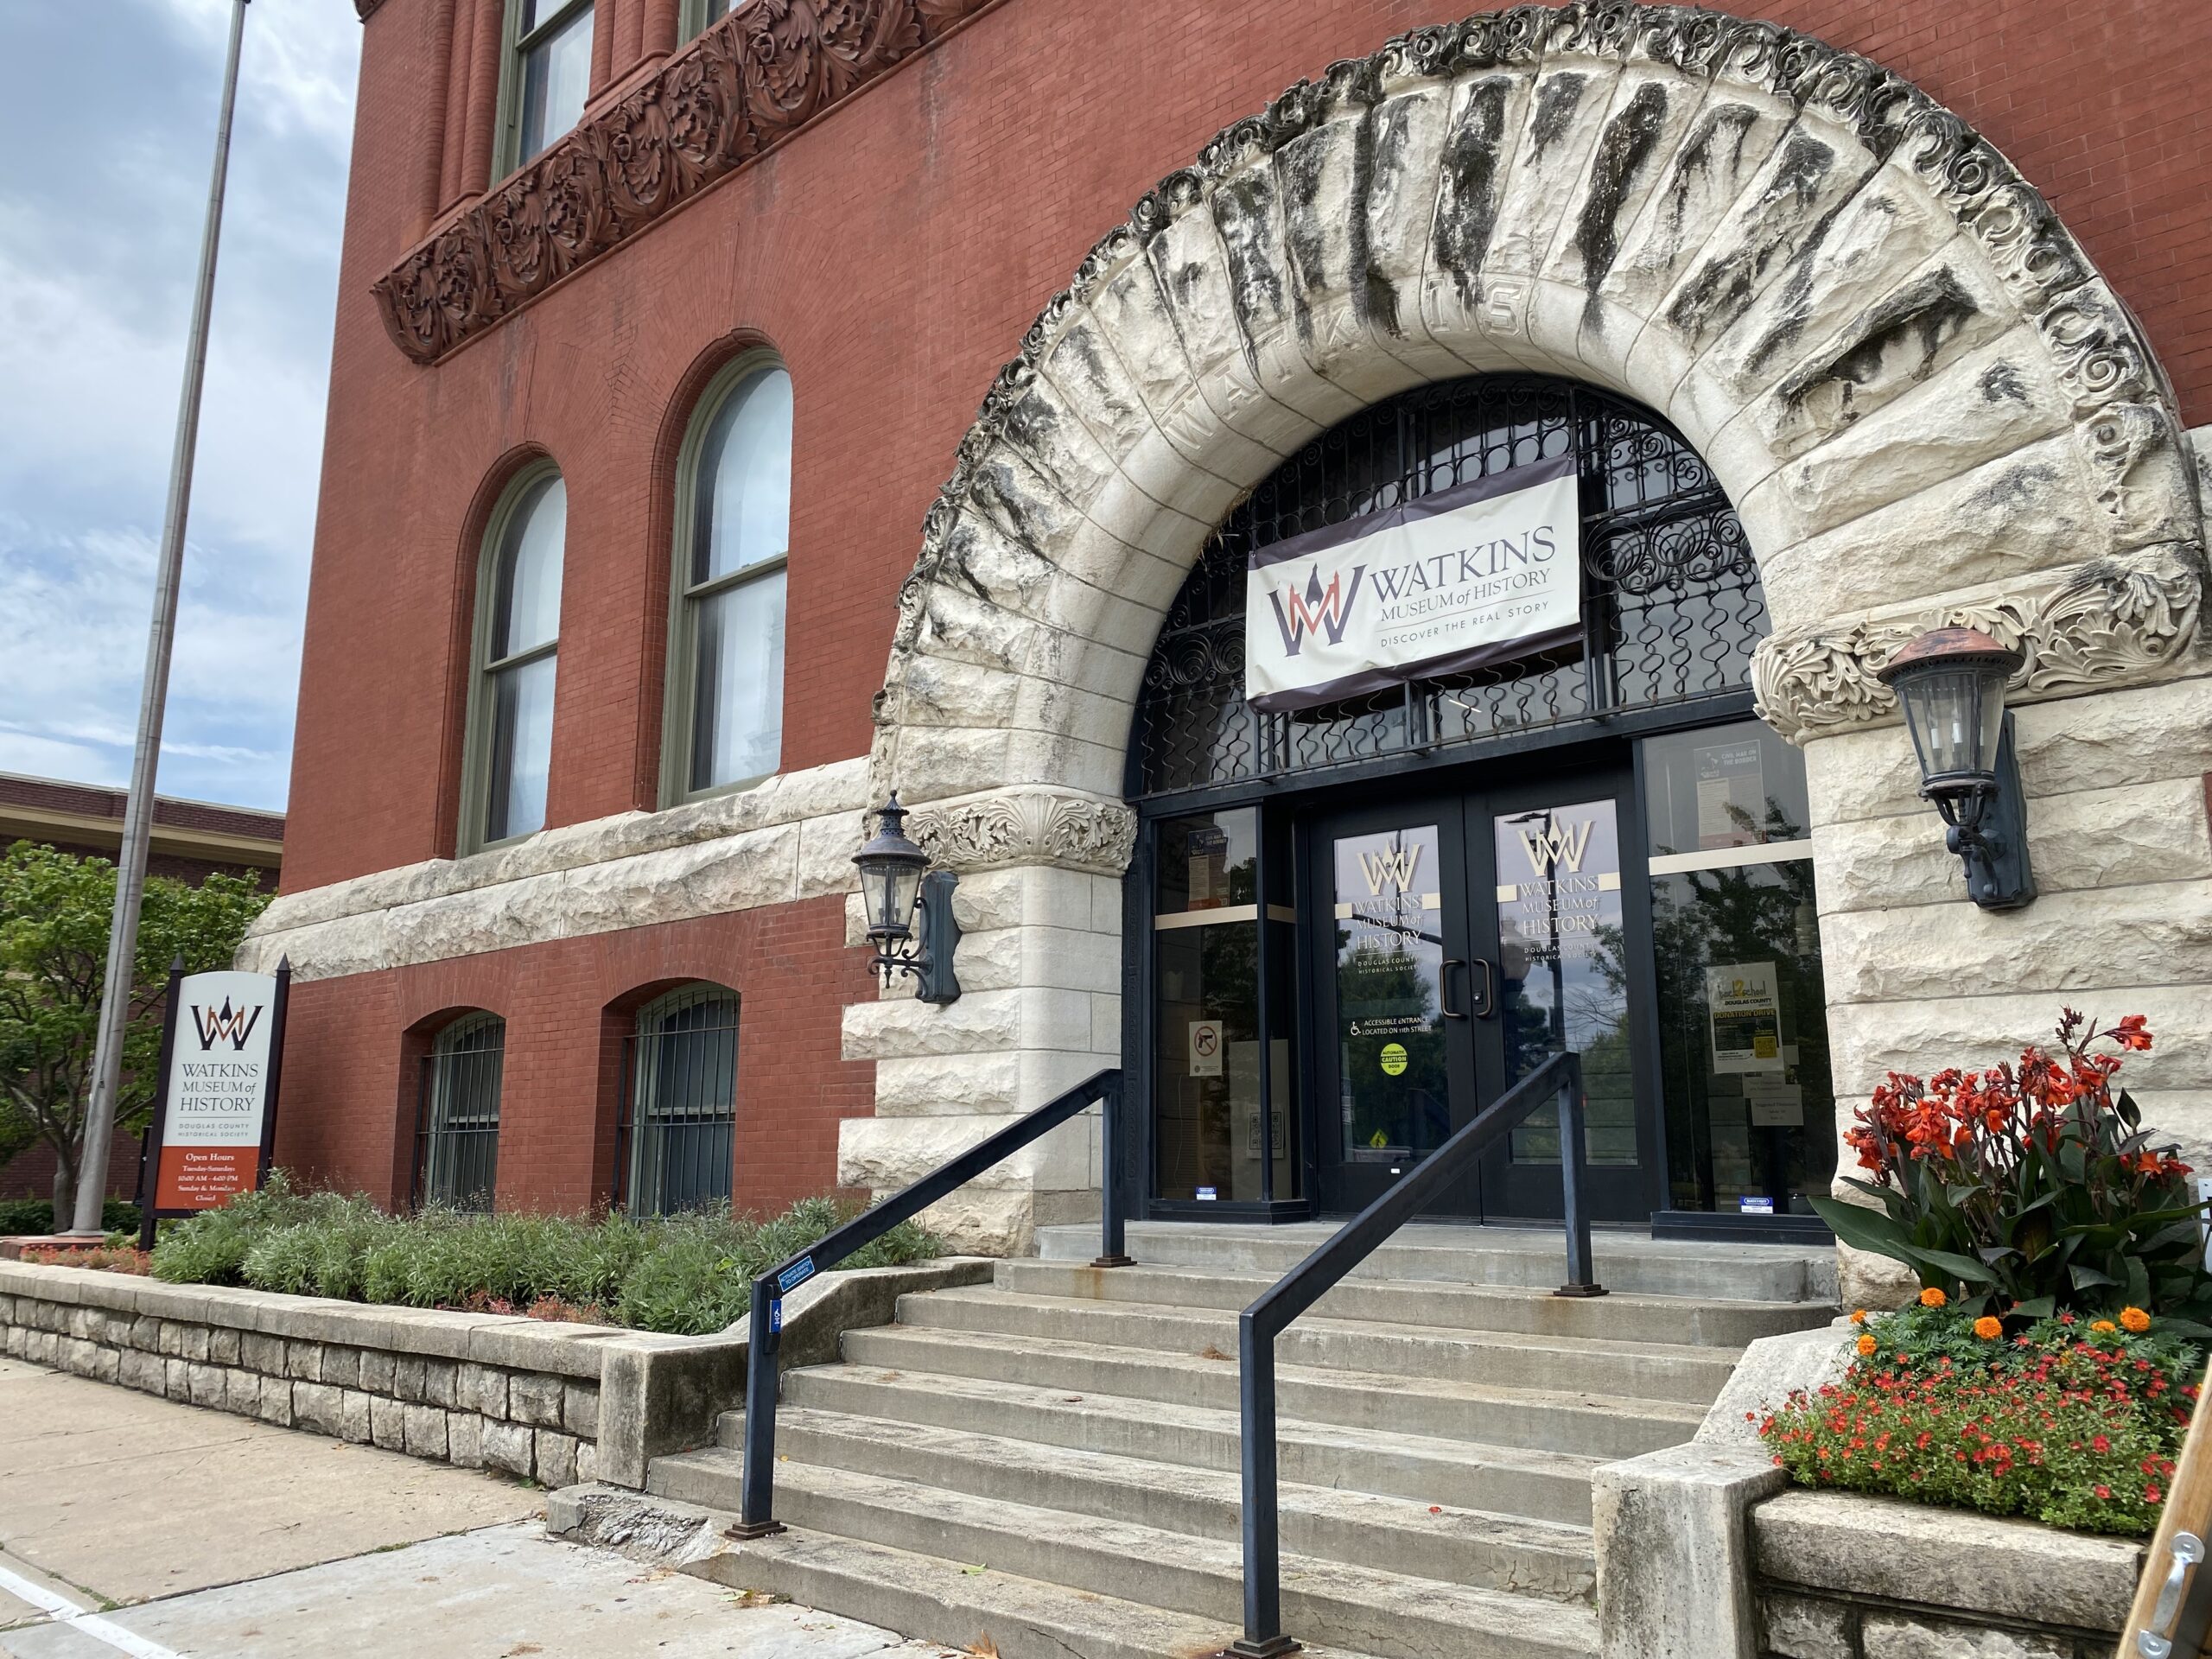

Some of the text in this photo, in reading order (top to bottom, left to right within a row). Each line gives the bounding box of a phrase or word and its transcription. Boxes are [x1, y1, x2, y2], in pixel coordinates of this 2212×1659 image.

[1370, 525, 1556, 603] WATKINS
[1381, 569, 1551, 622] MUSEUM of HISTORY
[1381, 601, 1549, 647] DISCOVER THE REAL STORY
[1520, 875, 1596, 897] WATKINS
[1354, 895, 1420, 913] WATKINS
[1522, 895, 1598, 914] MUSEUM of
[1357, 913, 1421, 930] MUSEUM of
[1523, 913, 1599, 935] HISTORY
[1357, 930, 1421, 950] HISTORY
[1524, 945, 1561, 954] DOUGLAS
[1357, 958, 1389, 967] DOUGLAS
[1714, 1010, 1752, 1019] DONATION
[1363, 1018, 1397, 1027] ACCESSIBLE
[182, 1064, 258, 1077] WATKINS
[182, 1081, 257, 1095] MUSEUM of
[180, 1097, 256, 1111] HISTORY
[185, 1153, 207, 1162] Open
[791, 1267, 809, 1281] OPERATE
